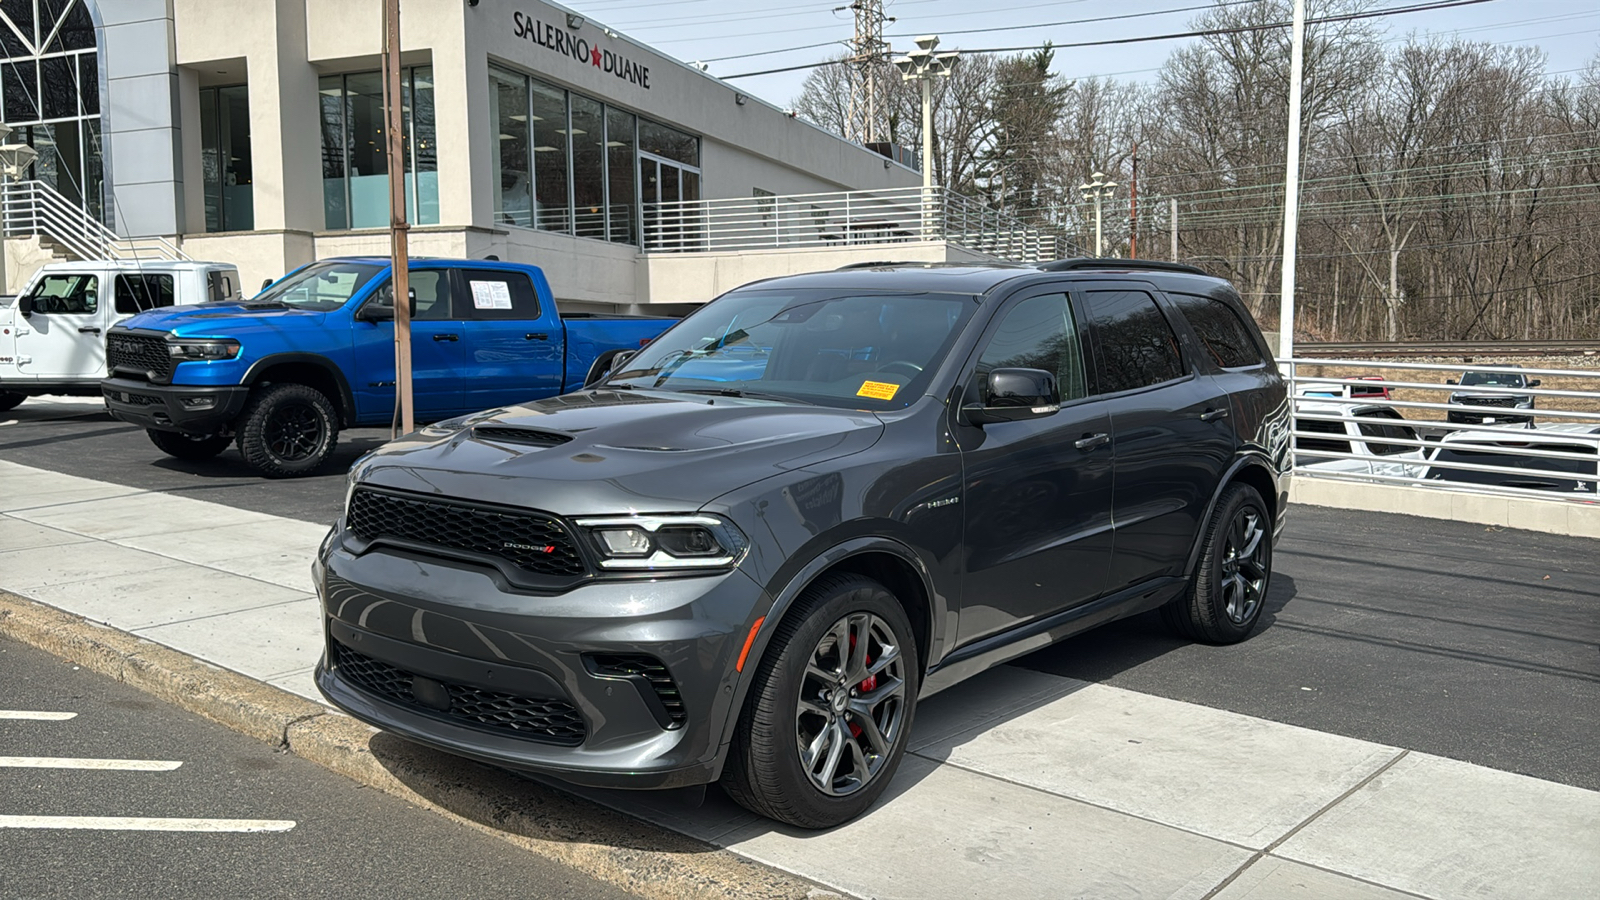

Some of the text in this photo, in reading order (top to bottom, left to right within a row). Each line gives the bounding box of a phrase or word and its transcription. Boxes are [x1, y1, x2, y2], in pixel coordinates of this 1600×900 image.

[513, 11, 650, 90] SALERNO DUANE
[503, 542, 547, 552] DODGE
